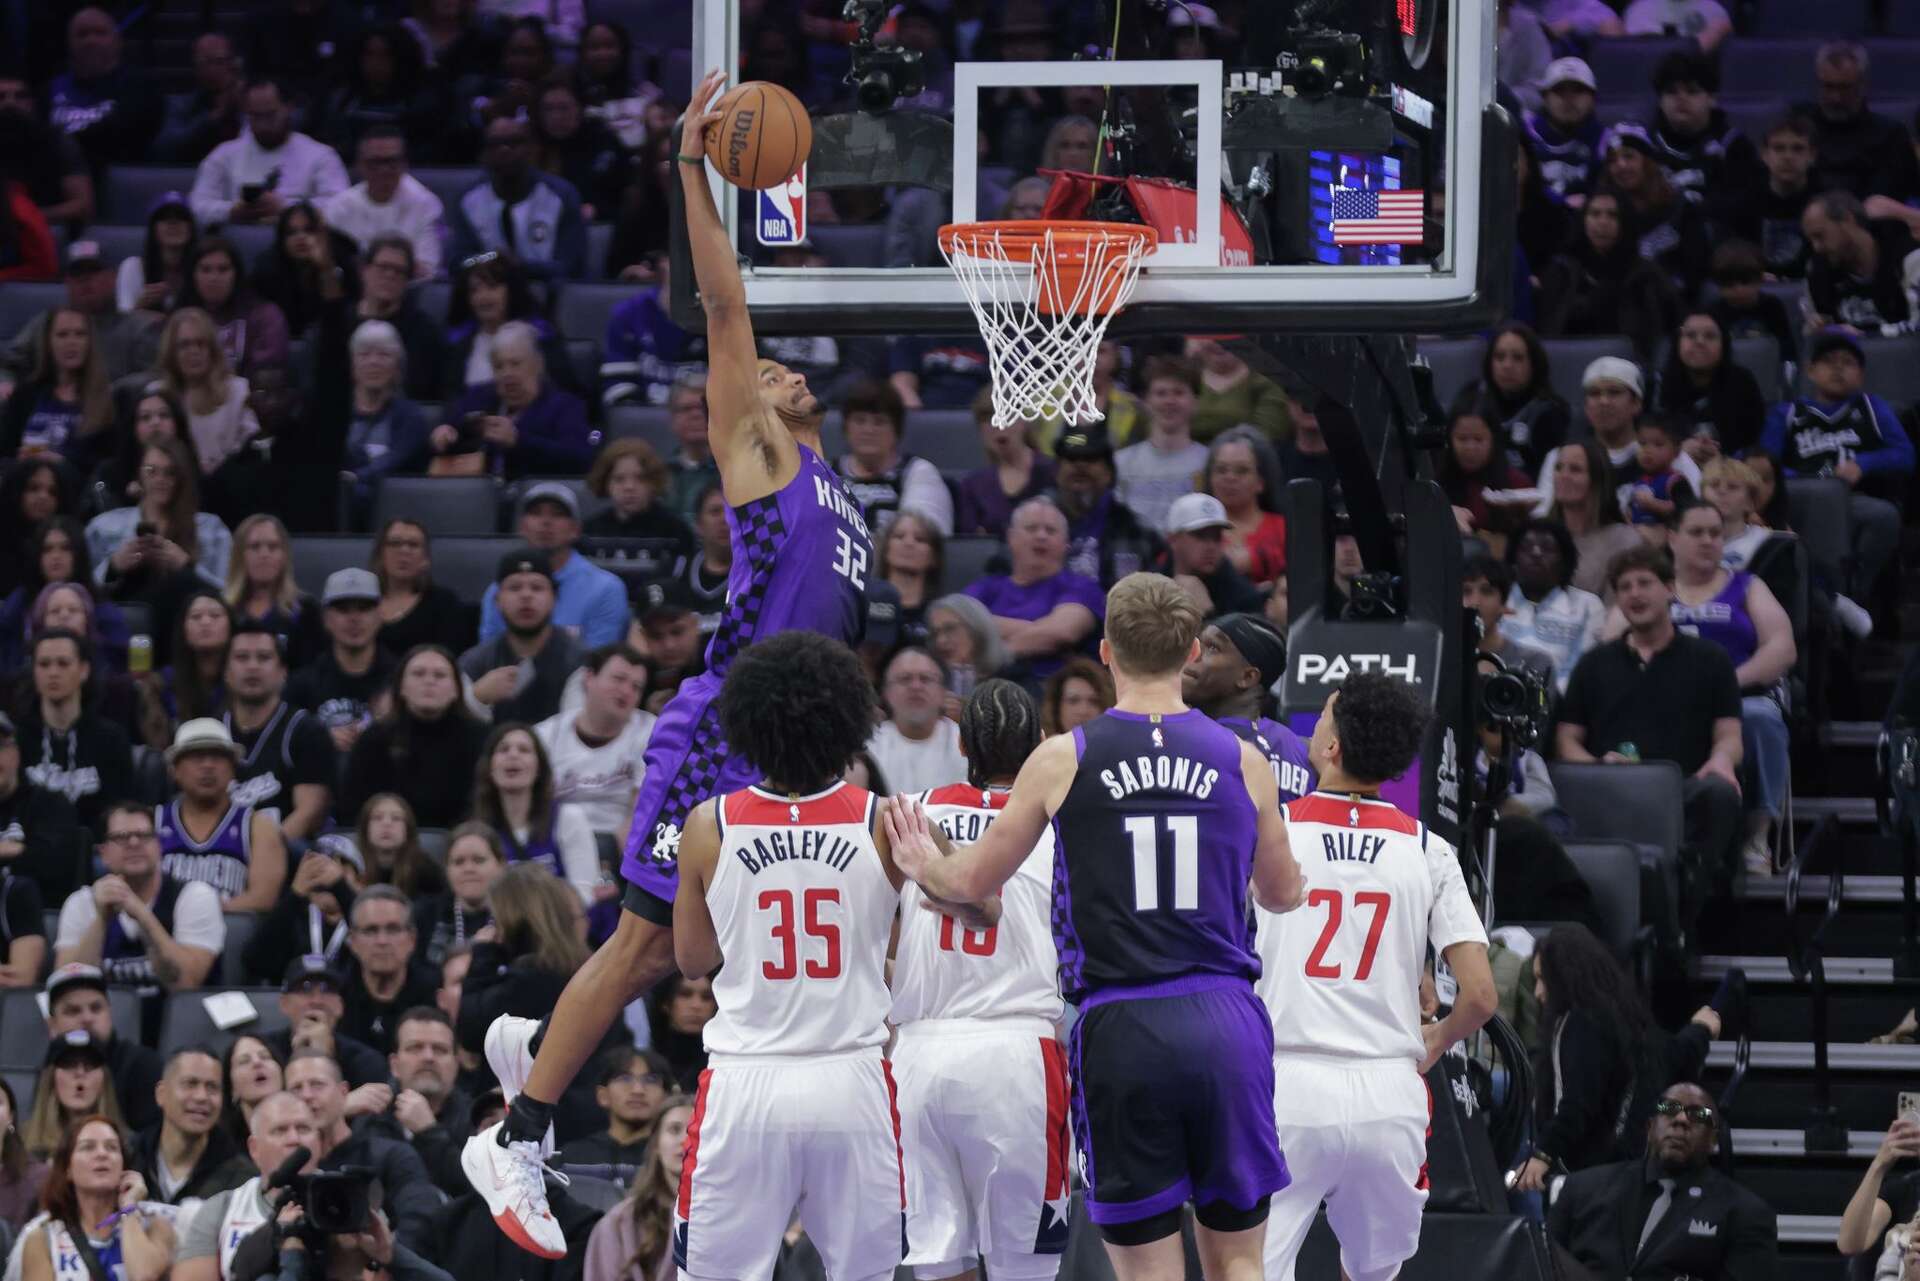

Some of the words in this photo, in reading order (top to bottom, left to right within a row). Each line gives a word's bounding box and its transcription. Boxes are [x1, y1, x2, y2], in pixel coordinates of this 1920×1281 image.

[729, 110, 755, 178] Wilson
[764, 219, 788, 238] NBA
[832, 527, 867, 591] 32
[1100, 755, 1219, 800] SABONIS
[736, 830, 827, 875] BAGLEY
[825, 836, 859, 872] III
[1125, 815, 1198, 911] 11
[1322, 832, 1386, 864] RILEY
[758, 888, 841, 980] 35
[1304, 888, 1391, 980] 27
